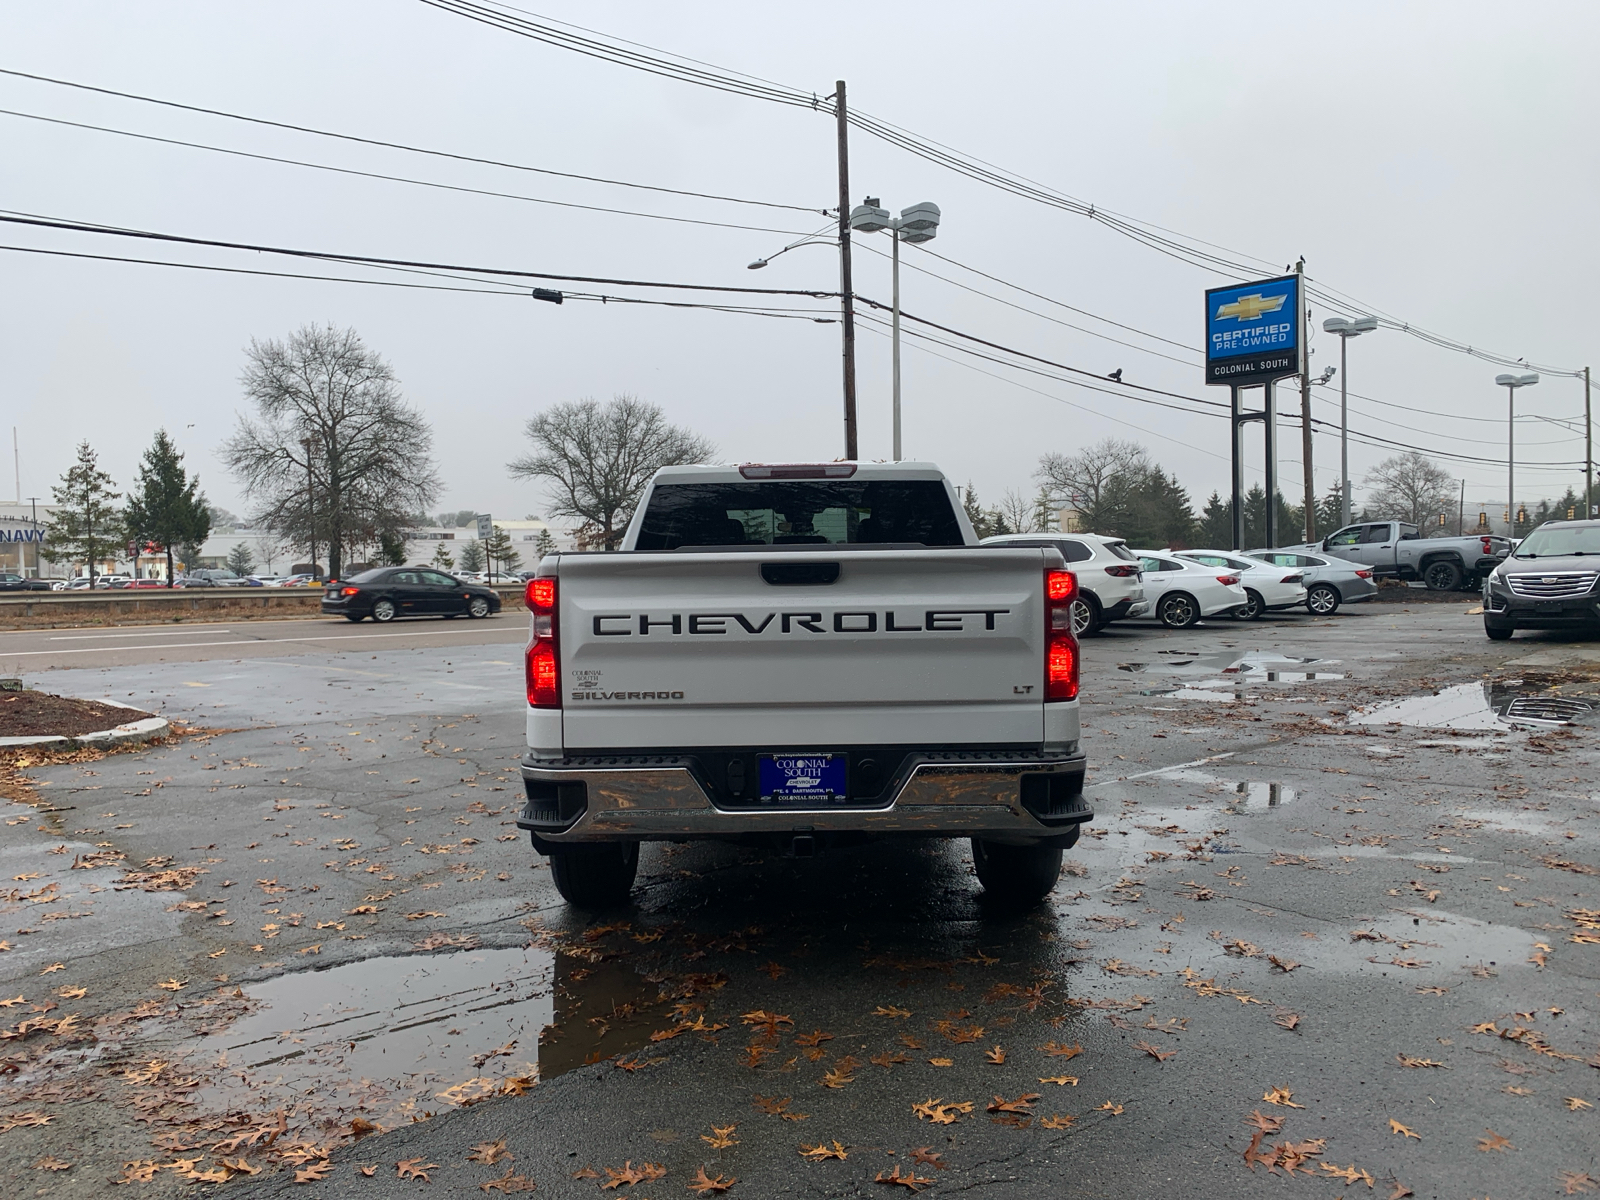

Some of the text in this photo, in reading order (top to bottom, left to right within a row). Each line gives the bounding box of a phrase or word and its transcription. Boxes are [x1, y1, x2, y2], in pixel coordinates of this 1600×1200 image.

[1212, 323, 1290, 342] CERTIFIED
[1216, 333, 1287, 350] PRE-OWNED
[1214, 358, 1289, 375] COLONIAL SOUTH
[0, 529, 46, 543] NAVY
[592, 609, 1010, 637] CHEVROLET
[571, 691, 685, 700] SILVERADO
[1013, 685, 1034, 694] LT
[776, 759, 829, 768] COLONIAL
[784, 768, 821, 776] SOUTH
